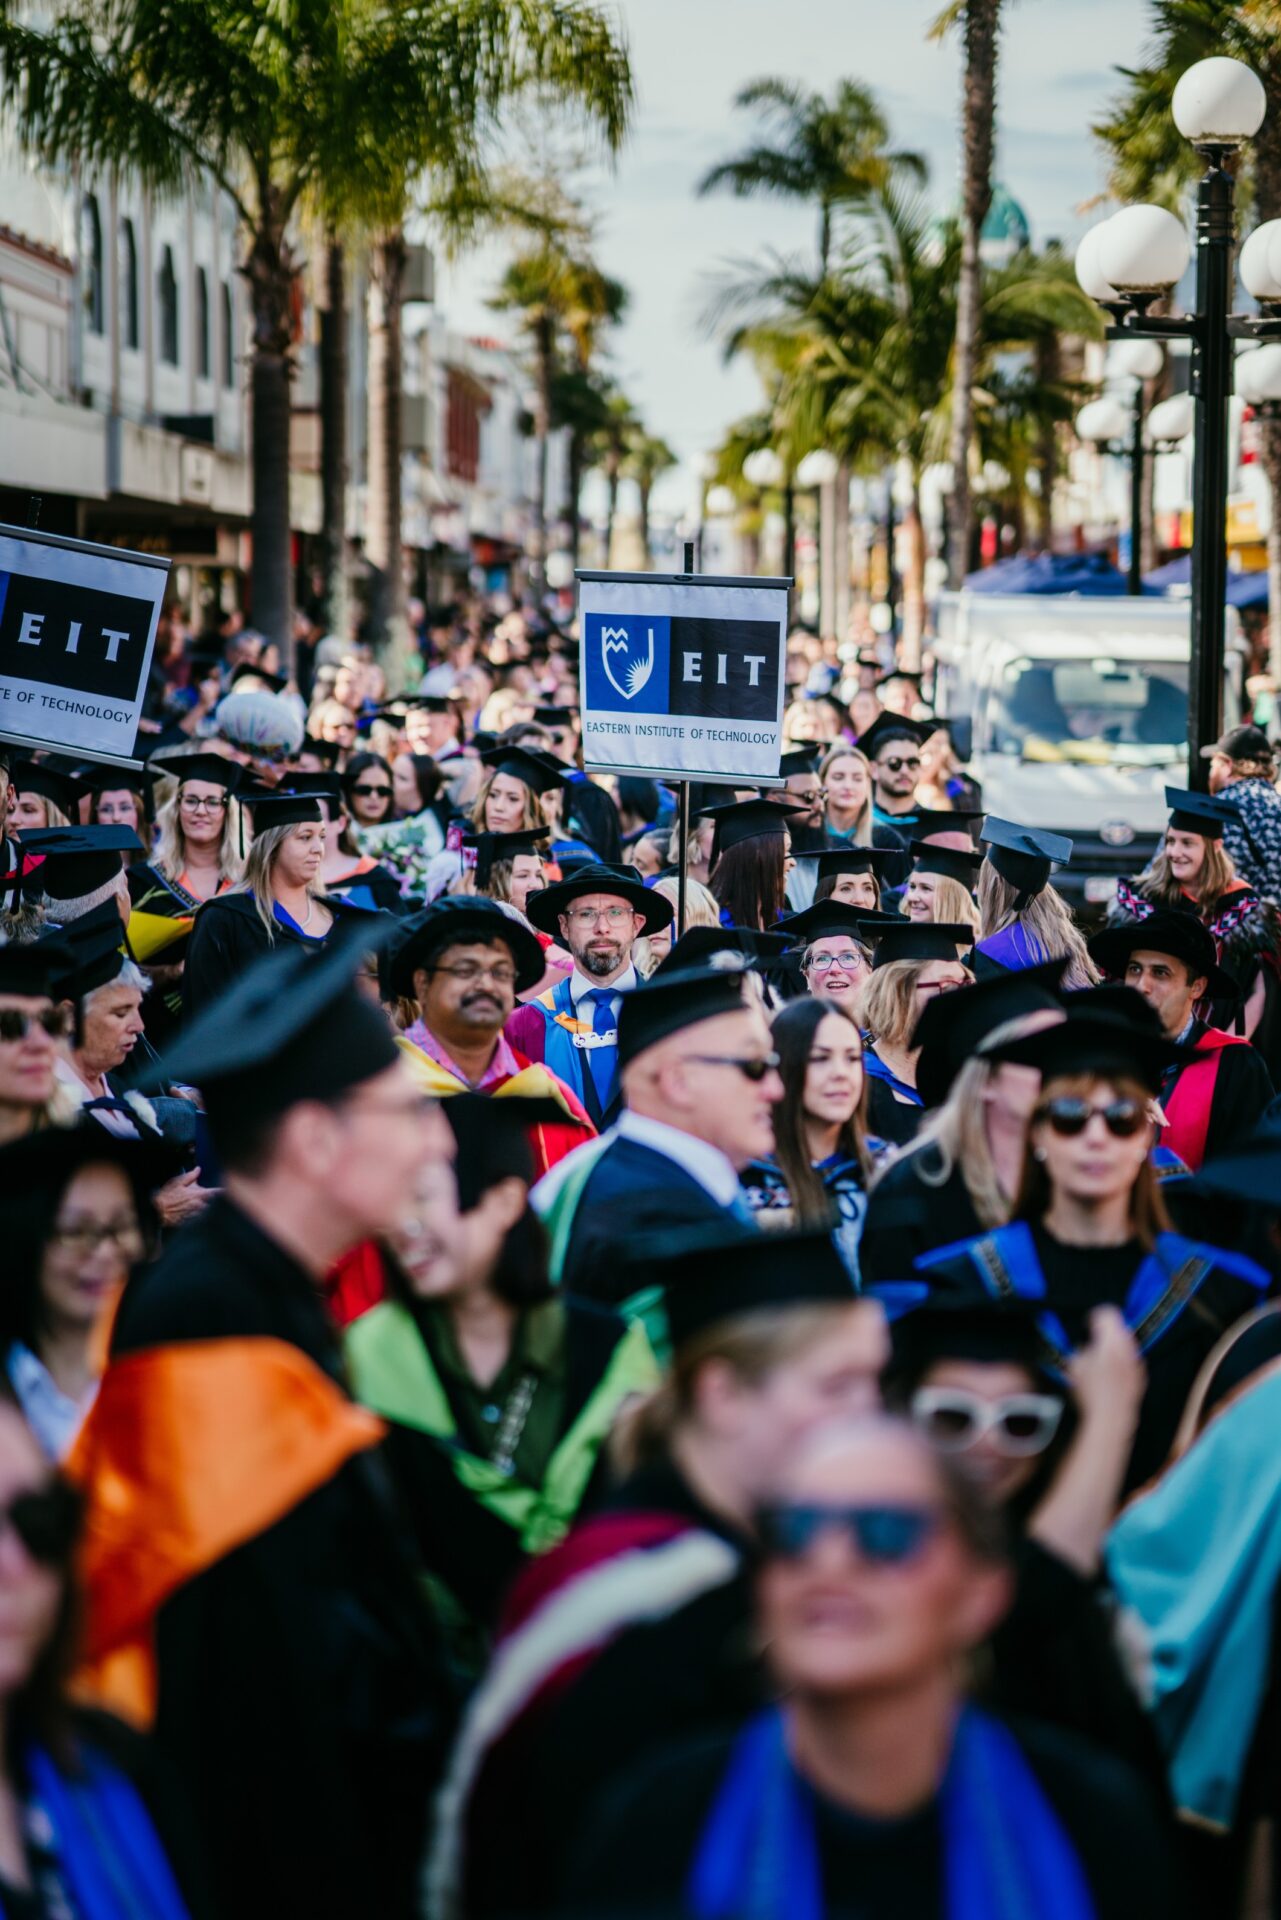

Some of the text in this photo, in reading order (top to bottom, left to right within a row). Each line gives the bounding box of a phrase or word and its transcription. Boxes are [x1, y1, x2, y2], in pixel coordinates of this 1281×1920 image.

[18, 612, 130, 662] EIT
[683, 651, 766, 686] EIT
[17, 691, 35, 703] OF
[41, 695, 133, 724] TECHNOLOGY
[586, 722, 777, 745] EASTERN INSTITUTE OF TECHNOLOGY
